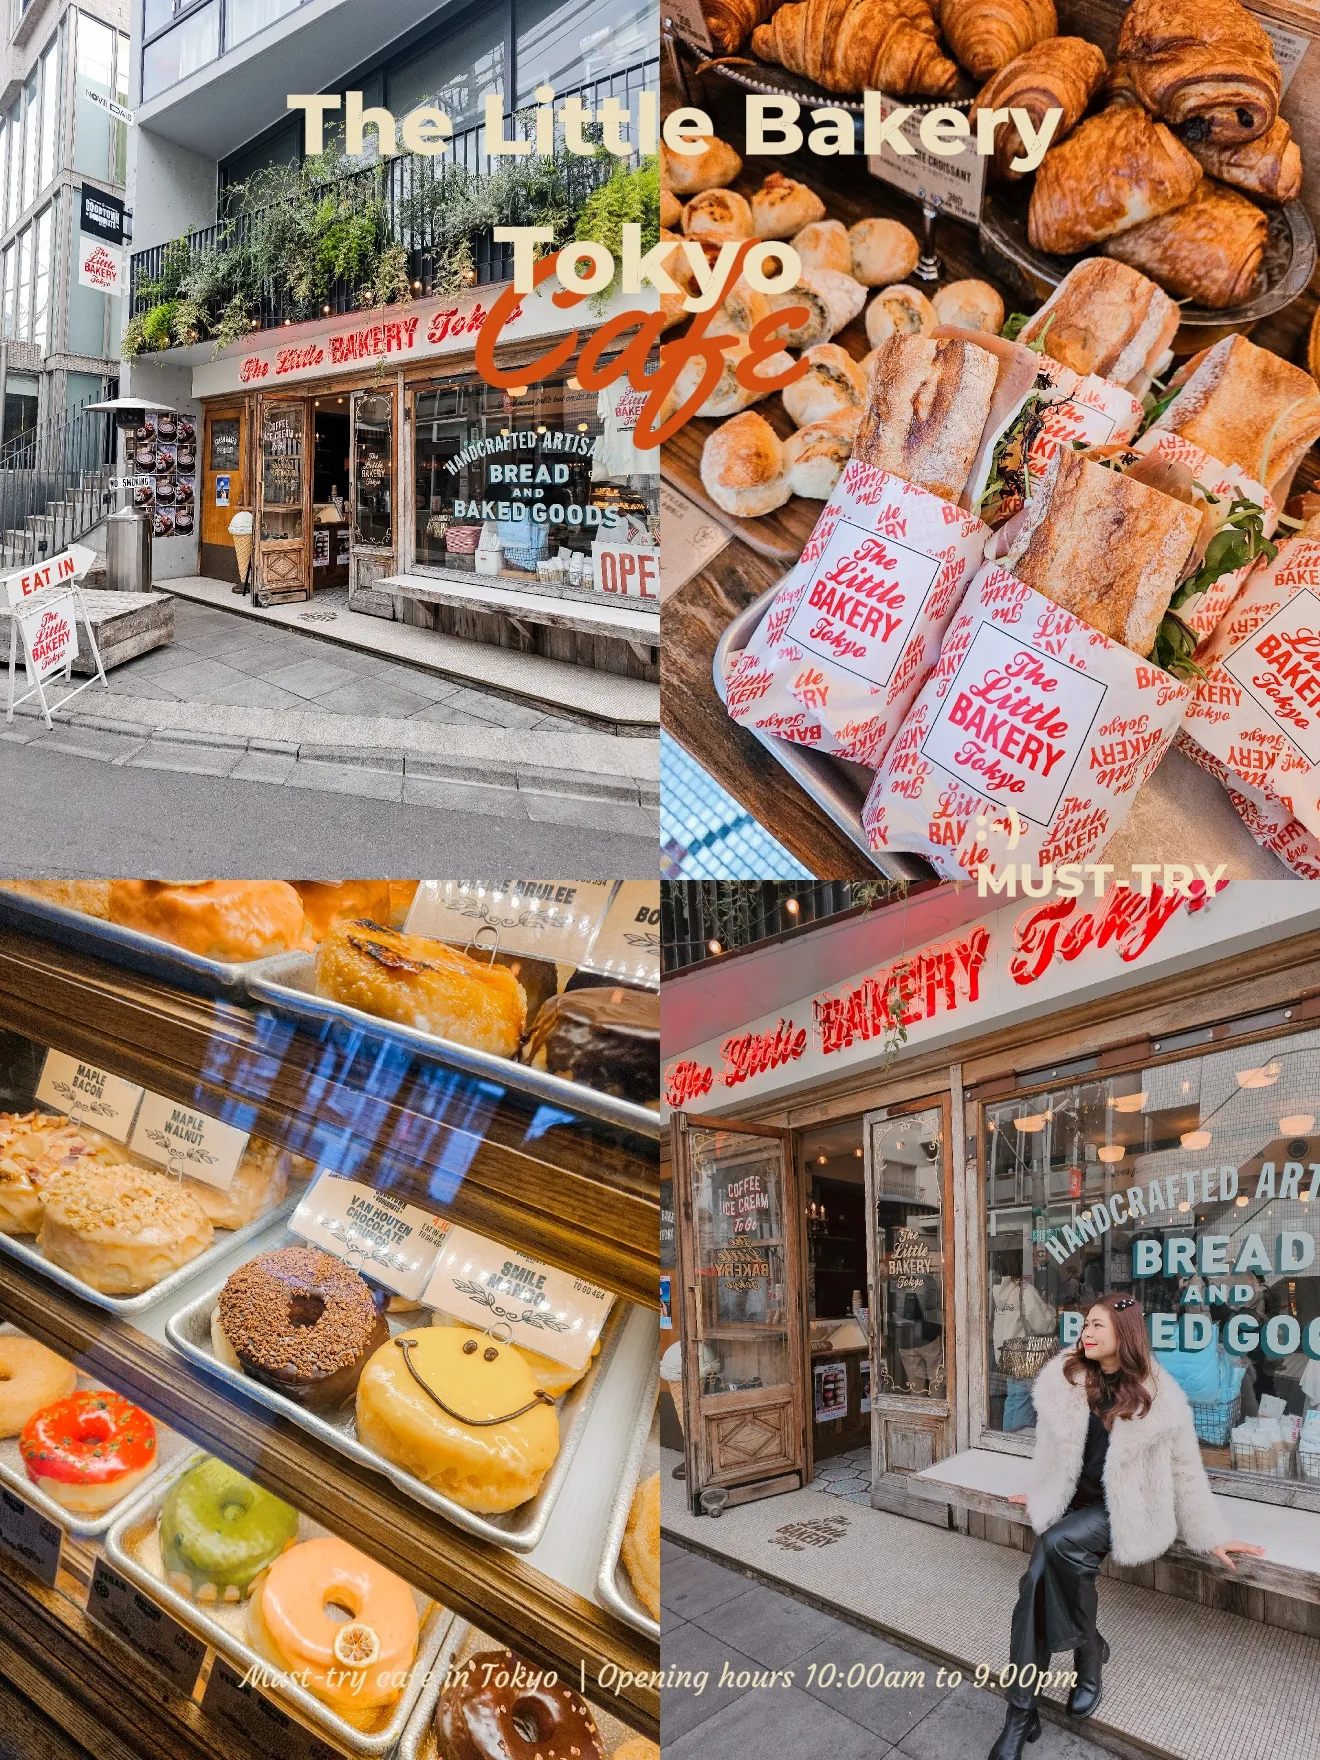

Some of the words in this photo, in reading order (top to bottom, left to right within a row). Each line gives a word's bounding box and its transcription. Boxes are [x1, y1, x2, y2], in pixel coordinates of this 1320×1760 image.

[928, 153, 972, 184] CROISSANT
[87, 252, 116, 270] Little
[94, 246, 109, 257] The
[84, 261, 117, 281] BAKERY
[90, 274, 111, 287] Tokyo
[239, 357, 269, 383] The
[274, 344, 323, 375] Little
[328, 316, 419, 363] BAKERY
[427, 302, 523, 344] Toko
[617, 394, 648, 406] Litt
[269, 419, 290, 431] COFFEE
[623, 416, 638, 426] Tok
[264, 430, 273, 441] ICE
[274, 428, 294, 440] CREAM
[443, 431, 536, 476] HANDCRAFTED
[543, 431, 603, 462] ARTISA
[361, 469, 385, 478] BAKERY
[488, 464, 570, 486] BREAD
[843, 461, 875, 484] ERY
[510, 487, 545, 498] AND
[856, 487, 883, 506] The
[452, 500, 531, 522] BAKED
[532, 503, 622, 529] GOODS
[854, 538, 899, 571] The
[21, 567, 51, 596] EAT
[58, 557, 75, 579] IN
[600, 550, 660, 600] OPE
[825, 556, 907, 610] Little
[41, 611, 59, 628] The
[808, 579, 904, 644] BAKERY
[991, 602, 1024, 625] The
[34, 619, 68, 647] Little
[809, 617, 867, 658] Tokyo
[31, 629, 71, 663] BAKERY
[41, 650, 66, 671] Tokyo
[738, 654, 760, 675] The
[1004, 651, 1058, 694] The
[726, 682, 773, 707] KERY
[969, 669, 1070, 740] Little
[1191, 683, 1243, 707] KERY
[1252, 672, 1310, 730] Tokyo
[755, 713, 806, 729] Tokyo
[1185, 701, 1231, 725] Tokyo
[947, 691, 1067, 778] BAKERY
[1098, 715, 1150, 737] Tokyo
[1089, 728, 1163, 770] BAKERY
[1239, 727, 1287, 751] Tokyo
[954, 740, 1026, 794] Tokyo
[891, 775, 925, 800] The
[1057, 796, 1093, 821] The
[1042, 809, 1108, 848] Little
[1038, 817, 1110, 868] BAKERY
[663, 1058, 713, 1109] The
[718, 1017, 807, 1088] Little
[812, 924, 992, 1056] BAKERY
[76, 1064, 107, 1087] MAPLE
[72, 1078, 104, 1099] BACON
[171, 1109, 205, 1132] MAPLE
[164, 1120, 205, 1147] WALNUT
[728, 1175, 761, 1199] COFFEE
[351, 1194, 375, 1215] VAN
[372, 1207, 414, 1237] HOUTEN
[722, 1200, 736, 1217] ICE
[738, 1192, 769, 1215] CREAM
[1045, 1165, 1240, 1266] HANDCRAFTED
[346, 1206, 405, 1246] CHOCOLATE
[348, 1221, 390, 1247] CRUNCH
[418, 1230, 426, 1239] TO
[426, 1235, 433, 1243] GO
[421, 1223, 431, 1233] EAT
[432, 1229, 440, 1237] IN
[734, 1217, 744, 1233] To
[744, 1216, 757, 1233] Go
[899, 1227, 919, 1242] The
[890, 1242, 929, 1259] Little
[1132, 1231, 1316, 1279] BREAD
[501, 1261, 547, 1290] SMILE
[888, 1258, 932, 1275] BAKERY
[486, 1273, 546, 1308] MANGO
[573, 1281, 581, 1291] TO
[582, 1285, 591, 1295] GO
[591, 1290, 606, 1301] 464
[897, 1275, 925, 1291] Tokyo
[1181, 1284, 1255, 1306] AND
[1060, 1311, 1214, 1352] BED
[775, 1523, 838, 1548] BAKERY
[100, 1569, 128, 1593] VEGAN
